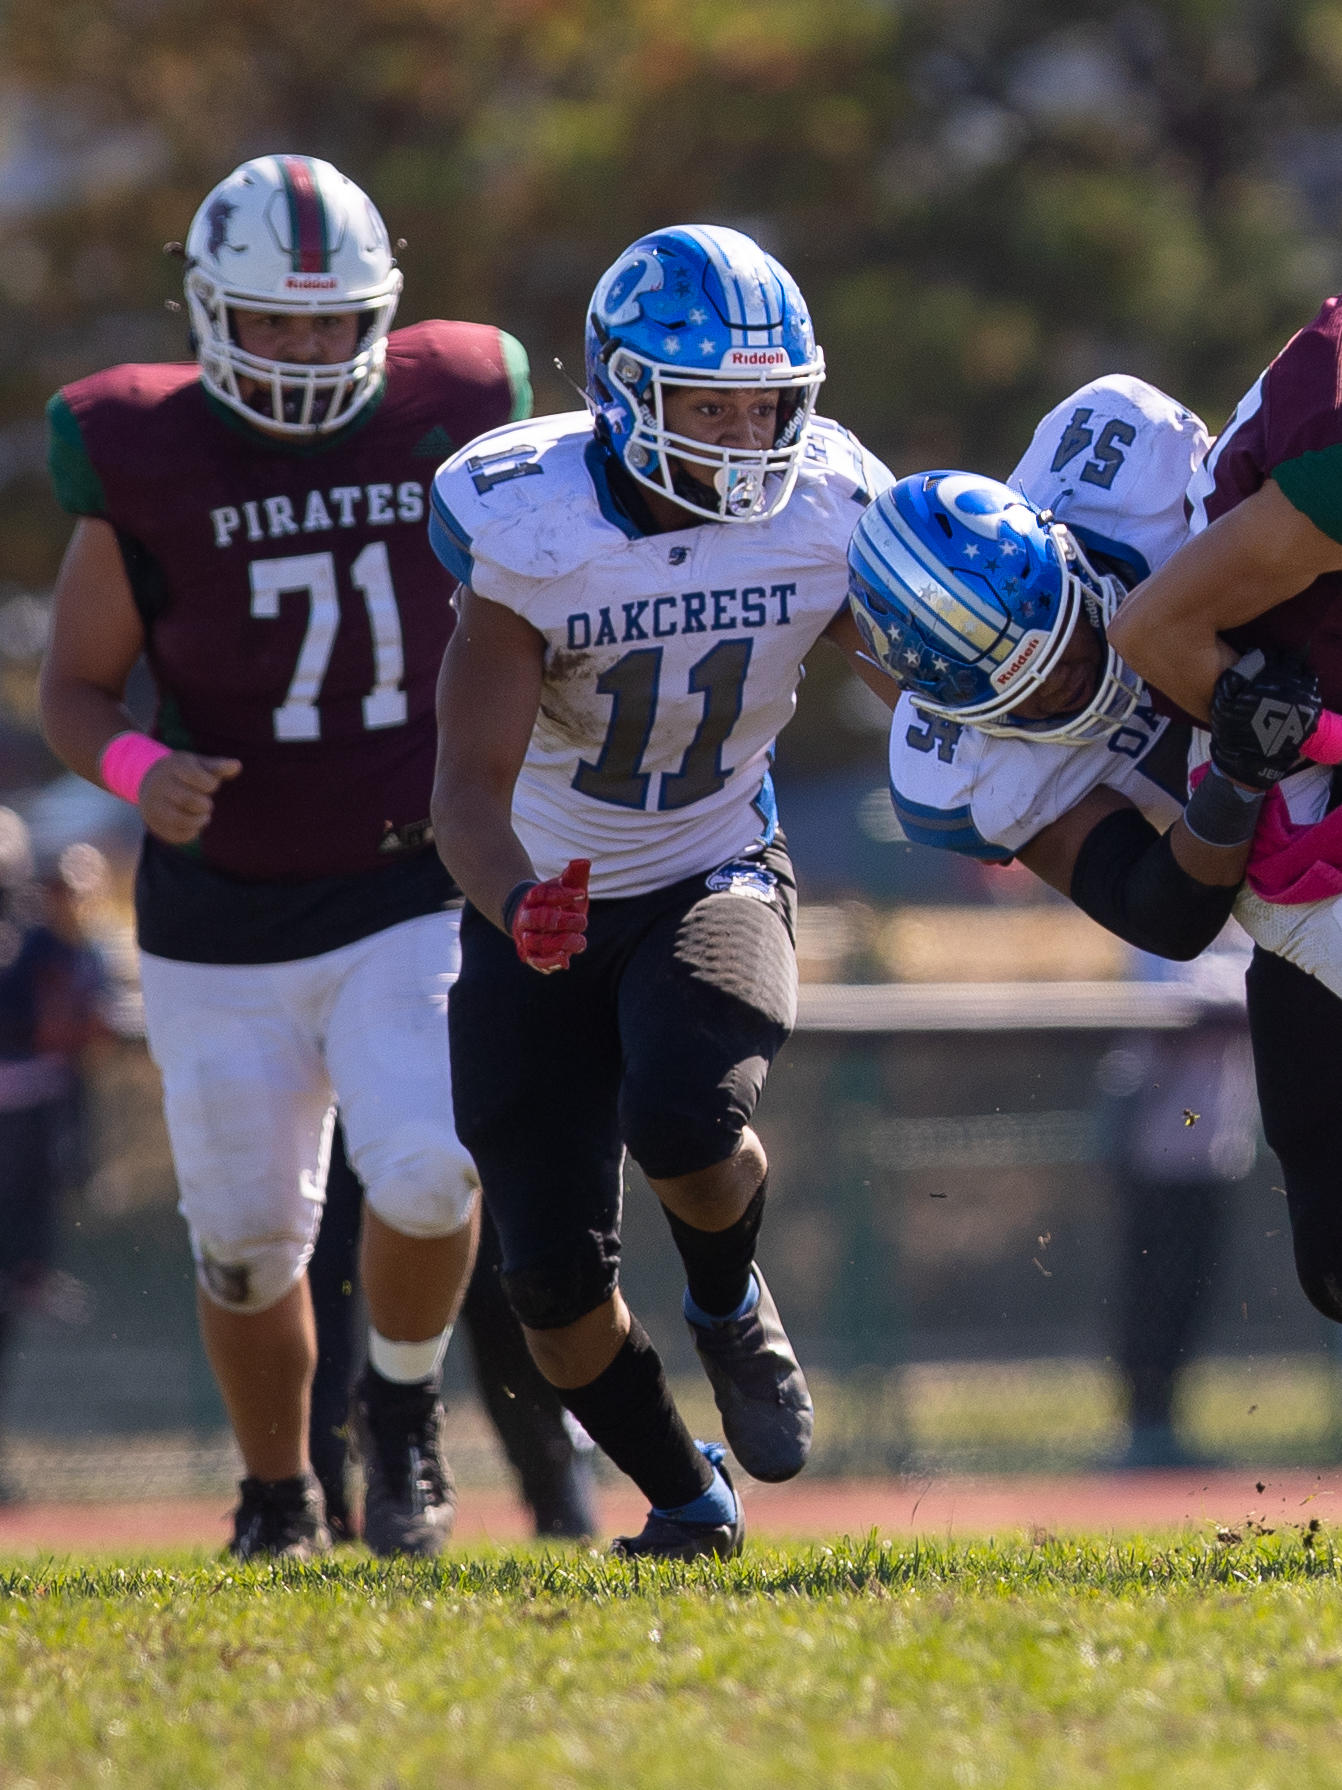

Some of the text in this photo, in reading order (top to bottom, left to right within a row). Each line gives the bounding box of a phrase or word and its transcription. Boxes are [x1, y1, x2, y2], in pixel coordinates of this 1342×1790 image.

[732, 352, 784, 365] Riddell
[465, 443, 545, 496] 11
[1050, 407, 1137, 491] 54
[210, 481, 425, 548] PIRATES
[248, 540, 408, 742] 71
[566, 582, 797, 650] OAKCREST
[997, 638, 1040, 685] Riddell
[570, 636, 755, 812] 11
